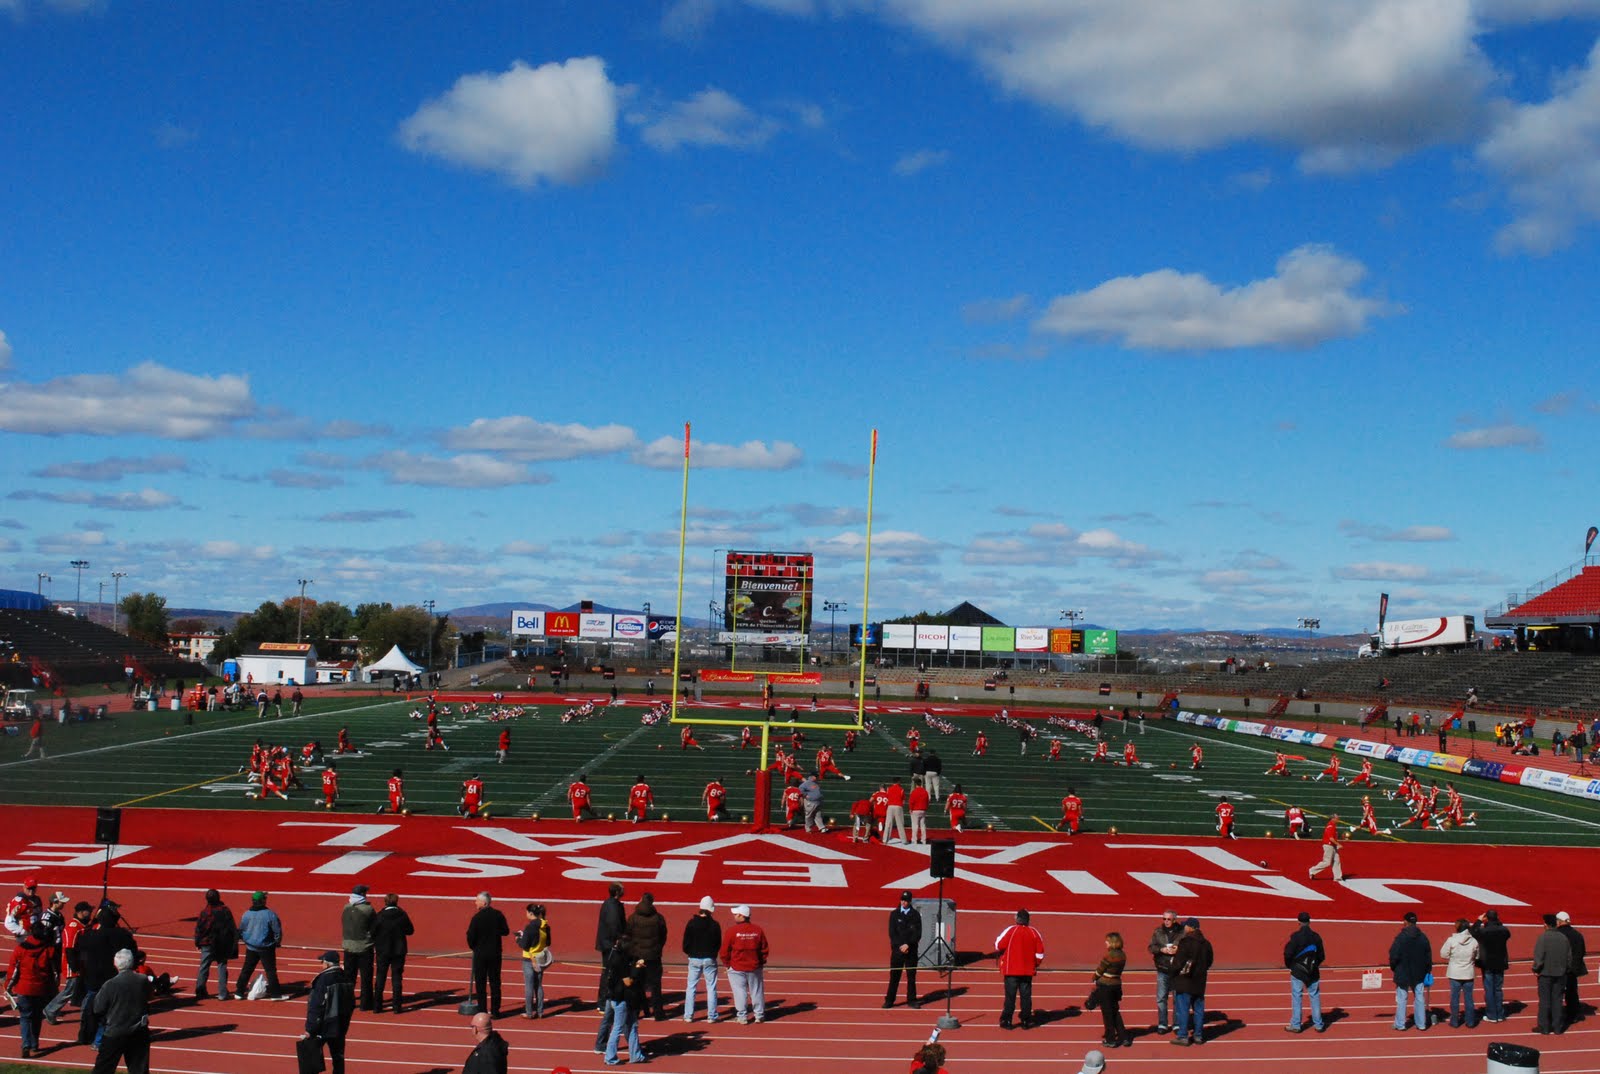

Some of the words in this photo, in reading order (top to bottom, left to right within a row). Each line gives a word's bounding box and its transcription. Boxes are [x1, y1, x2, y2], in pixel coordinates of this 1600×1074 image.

[741, 581, 799, 591] Bienvenue!
[517, 616, 539, 629] Bell
[467, 785, 477, 794] 61
[876, 796, 888, 806] 99
[1065, 801, 1077, 811] 93
[1220, 808, 1231, 817] 27
